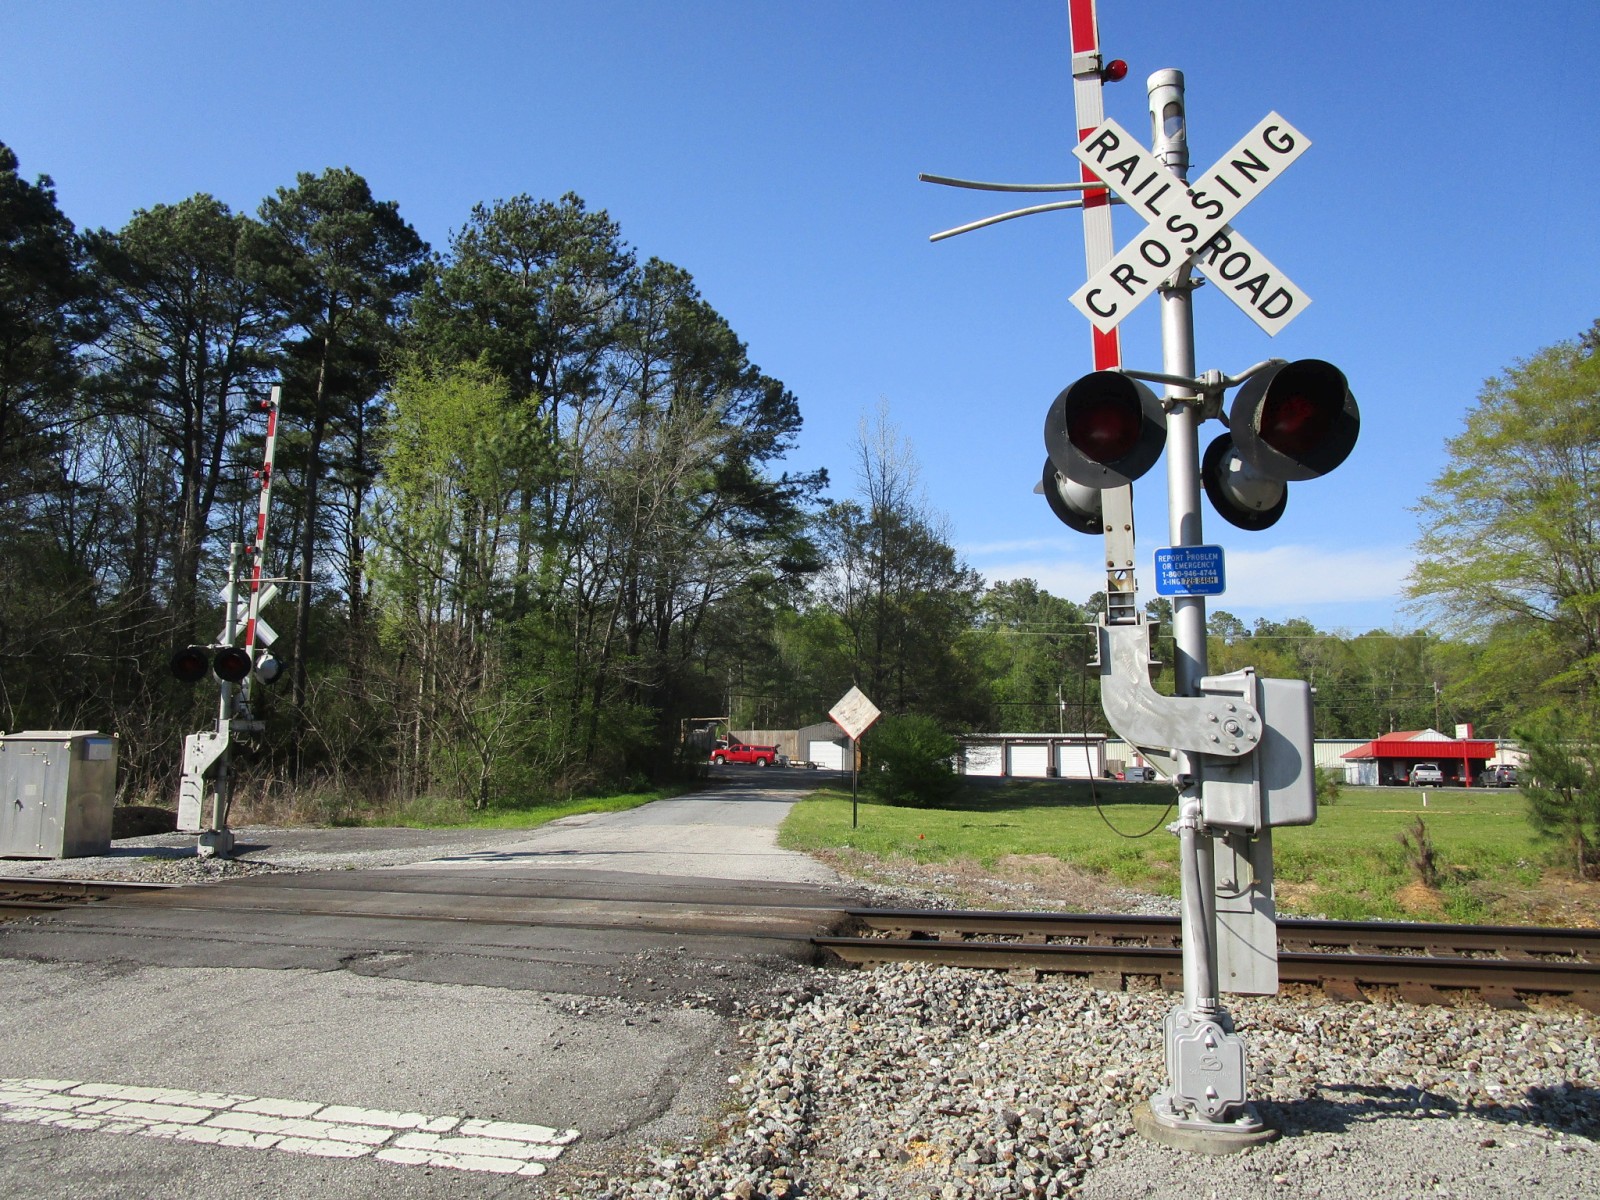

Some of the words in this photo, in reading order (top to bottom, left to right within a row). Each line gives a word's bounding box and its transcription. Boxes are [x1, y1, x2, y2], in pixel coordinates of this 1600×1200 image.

[1085, 125, 1295, 318] CROSSING
[1186, 553, 1218, 561] PROBLEM
[1174, 561, 1215, 570] EMERGENCY
[1162, 569, 1217, 578] 1-800-946-4744
[1185, 577, 1196, 585] 726
